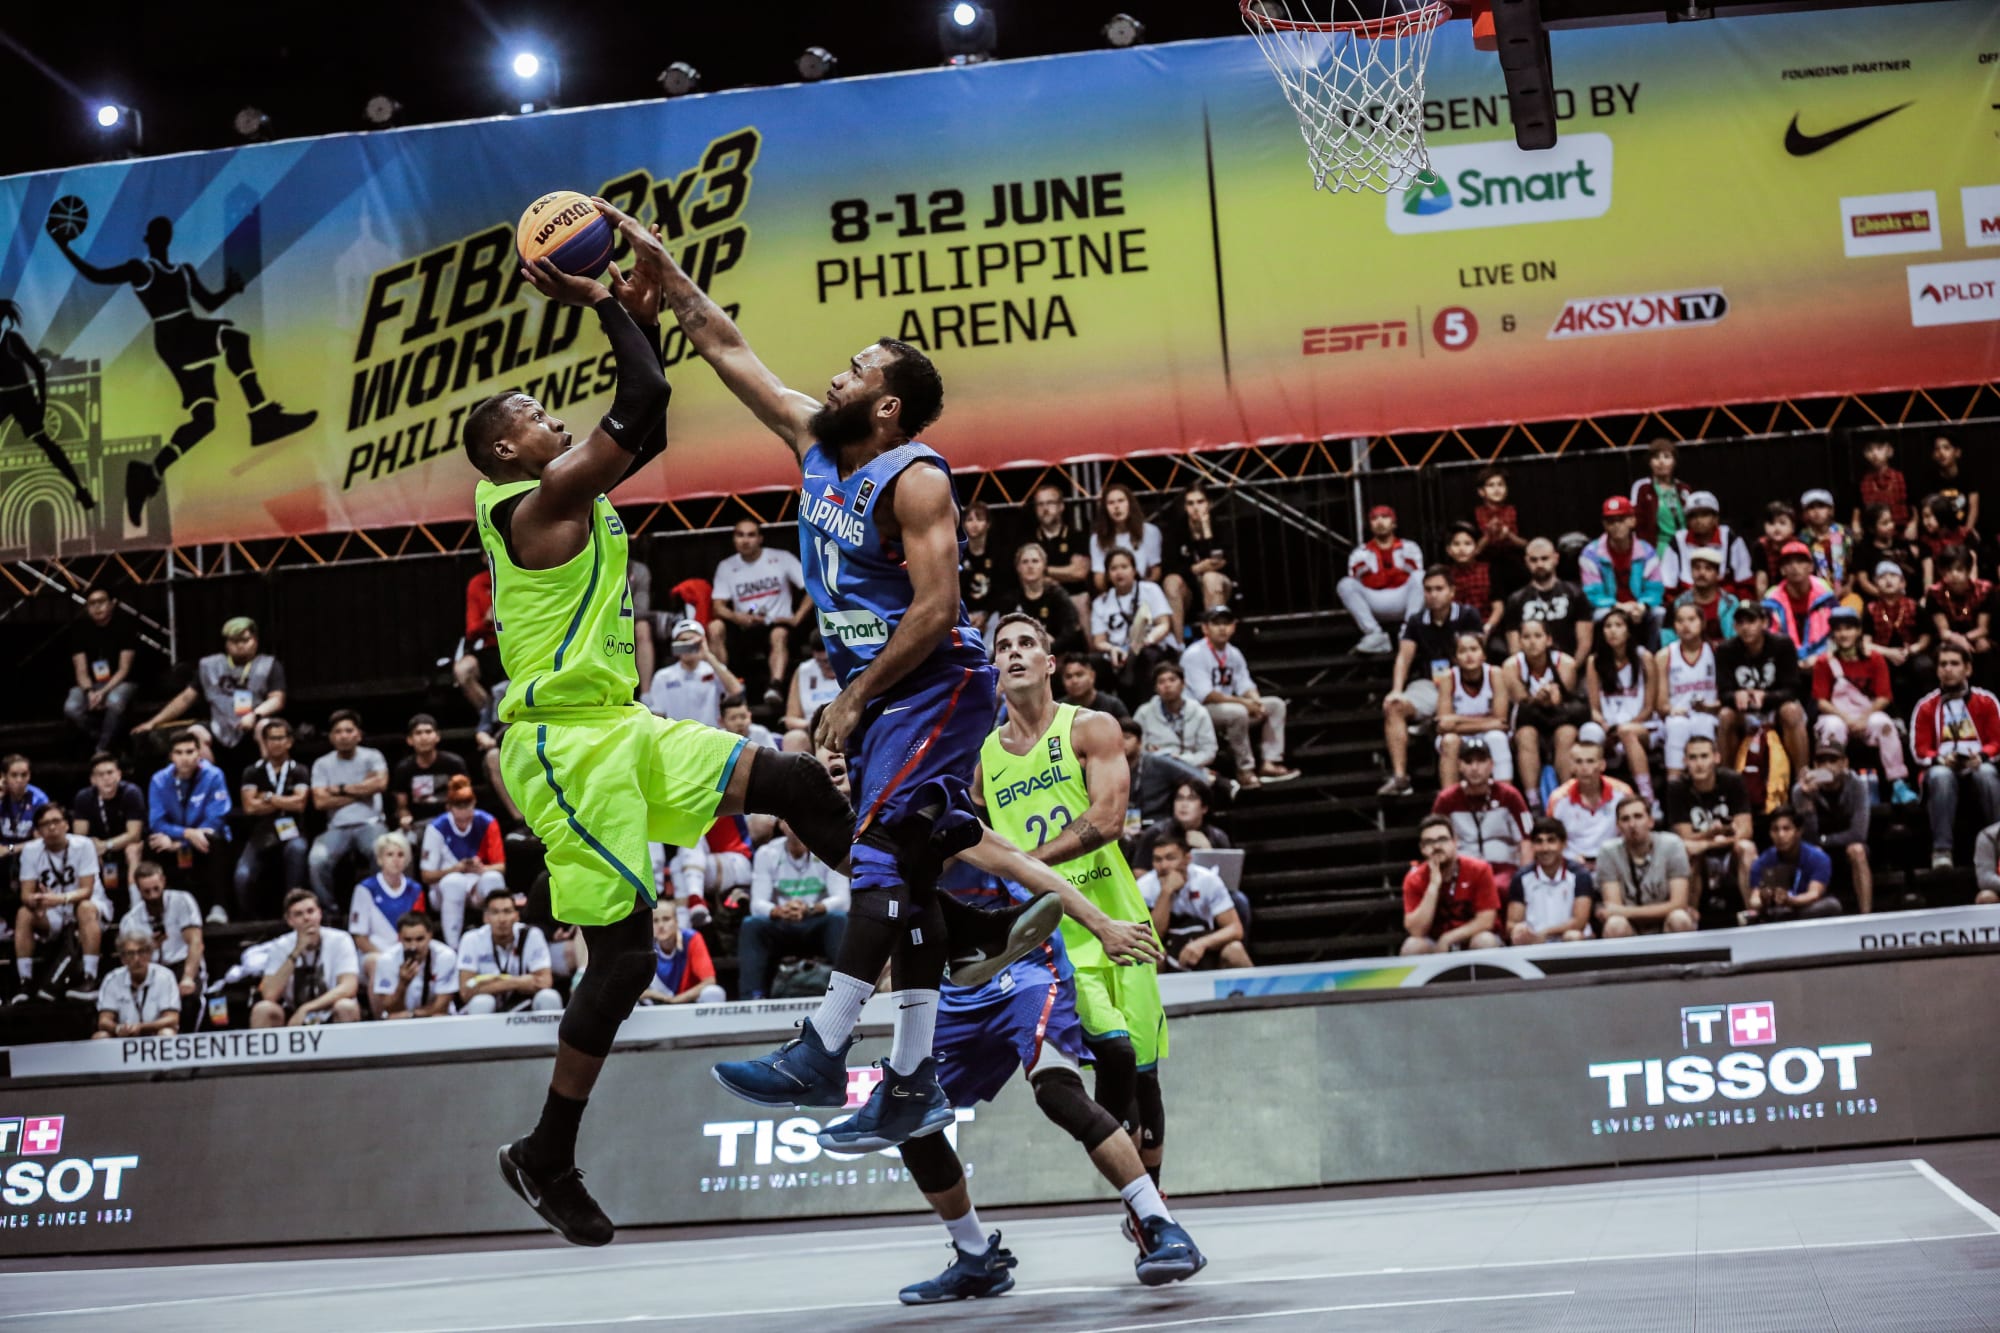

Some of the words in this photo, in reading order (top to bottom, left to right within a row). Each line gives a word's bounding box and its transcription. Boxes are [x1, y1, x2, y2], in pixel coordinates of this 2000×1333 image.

[1852, 59, 1911, 75] PARTNER
[1590, 82, 1641, 118] BY
[1458, 159, 1595, 208] Smart
[533, 201, 595, 246] Wilson
[830, 188, 967, 244] 8-12
[984, 171, 1126, 229] JUNE
[816, 228, 1150, 303] PHILIPPINE
[1458, 264, 1514, 289] LIVE
[1522, 260, 1557, 282] ON
[1942, 281, 1996, 301] PLDT
[899, 294, 1078, 351] ARENA
[1302, 321, 1407, 356] ESPN
[1502, 314, 1518, 334] &
[346, 299, 584, 432] WORLD
[799, 487, 865, 547] PILIPINAS
[735, 576, 781, 597] CANADA
[994, 765, 1072, 809] BRASIL
[506, 1014, 561, 1027] FOUNDIN
[695, 1004, 752, 1017] OFFICIAL
[121, 1032, 280, 1064] PRESENTED
[288, 1029, 324, 1054] BY
[1588, 1042, 1872, 1109] TISSOT
[1664, 1107, 1757, 1130] WATCHES
[1766, 1102, 1825, 1122] SINCE
[769, 1169, 858, 1189] WATCHES
[37, 1211, 88, 1228] SINCE
